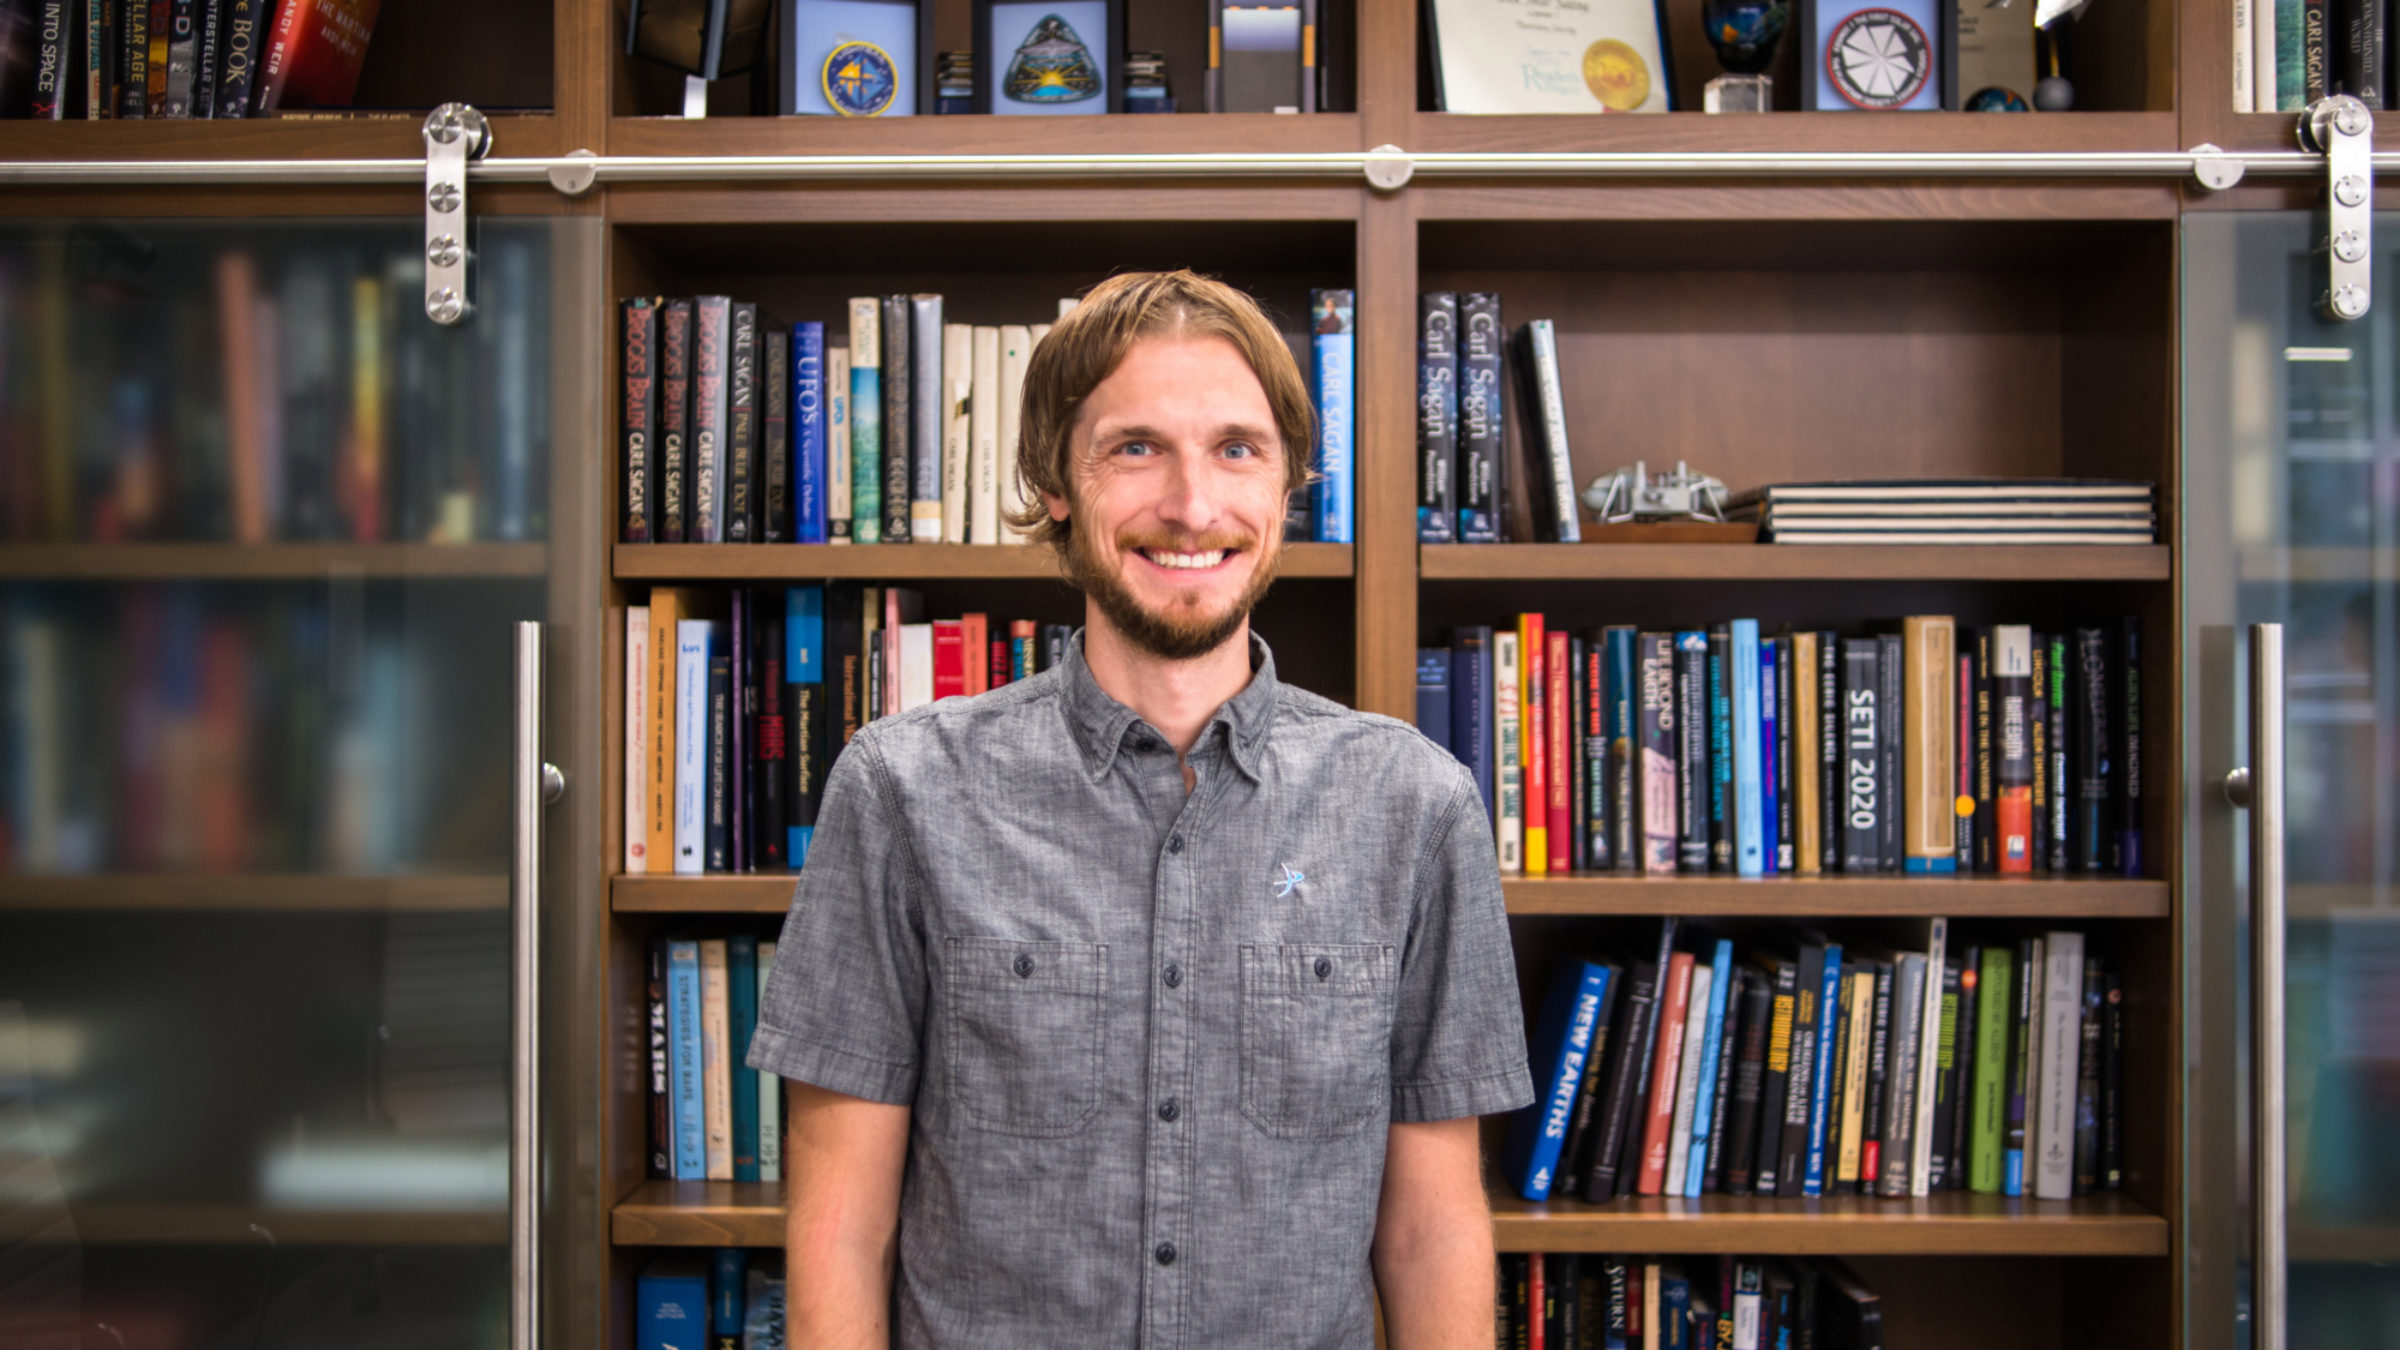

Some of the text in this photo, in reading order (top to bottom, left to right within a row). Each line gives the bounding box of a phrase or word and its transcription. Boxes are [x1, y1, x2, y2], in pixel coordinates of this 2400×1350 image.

[38, 2, 61, 93] INTO SPACE
[226, 18, 253, 86] BOOK
[267, 0, 298, 76] ANDY WEIR
[2306, 9, 2323, 89] CARL SAGAN
[131, 51, 146, 83] AGE
[735, 309, 752, 407] CARL SAGAN
[1420, 310, 1451, 438] Carl Sagan
[1463, 312, 1495, 440] Carl Sagan
[627, 376, 651, 430] BRAIN
[664, 378, 687, 431] BRAIN
[697, 376, 722, 429] BRAIN
[798, 356, 818, 425] UFO'S
[1322, 351, 1342, 473] CARL SAGAN
[628, 432, 645, 467] CARL
[666, 434, 681, 470] CARL
[698, 431, 714, 466] CARL
[733, 413, 749, 514] PALE BLUE DOT
[628, 469, 645, 514] SAGAN
[665, 471, 681, 515] SAGAN
[697, 468, 714, 514] SAGAN
[802, 483, 814, 520] Debate
[1425, 450, 1436, 504] Poundstone
[1436, 458, 1447, 494] William
[1469, 452, 1480, 506] Poundstone
[1480, 461, 1490, 496] William
[1643, 658, 1660, 711] EARTH
[1657, 639, 1674, 731] LIFE BEYOND
[1823, 646, 1836, 763] THE EERIE SILENCE
[1979, 690, 1990, 712] LIFE
[800, 690, 812, 795] The Martian Surface
[1850, 688, 1876, 830] SETI 2020
[1979, 729, 1990, 749] THE
[1979, 750, 1991, 801] UNIVERSE
[679, 975, 692, 1043] STRATEGIES
[1825, 980, 1836, 998] The
[1879, 973, 1891, 993] THE
[1545, 992, 1599, 1140] NEW EARTHS
[1800, 1030, 1814, 1083] ORIGINS
[1873, 1029, 1887, 1071] SILENCE
[682, 1070, 694, 1101] MARS
[1786, 1062, 1802, 1124] UNIVERSE
[1605, 1260, 1626, 1330] SATURN
